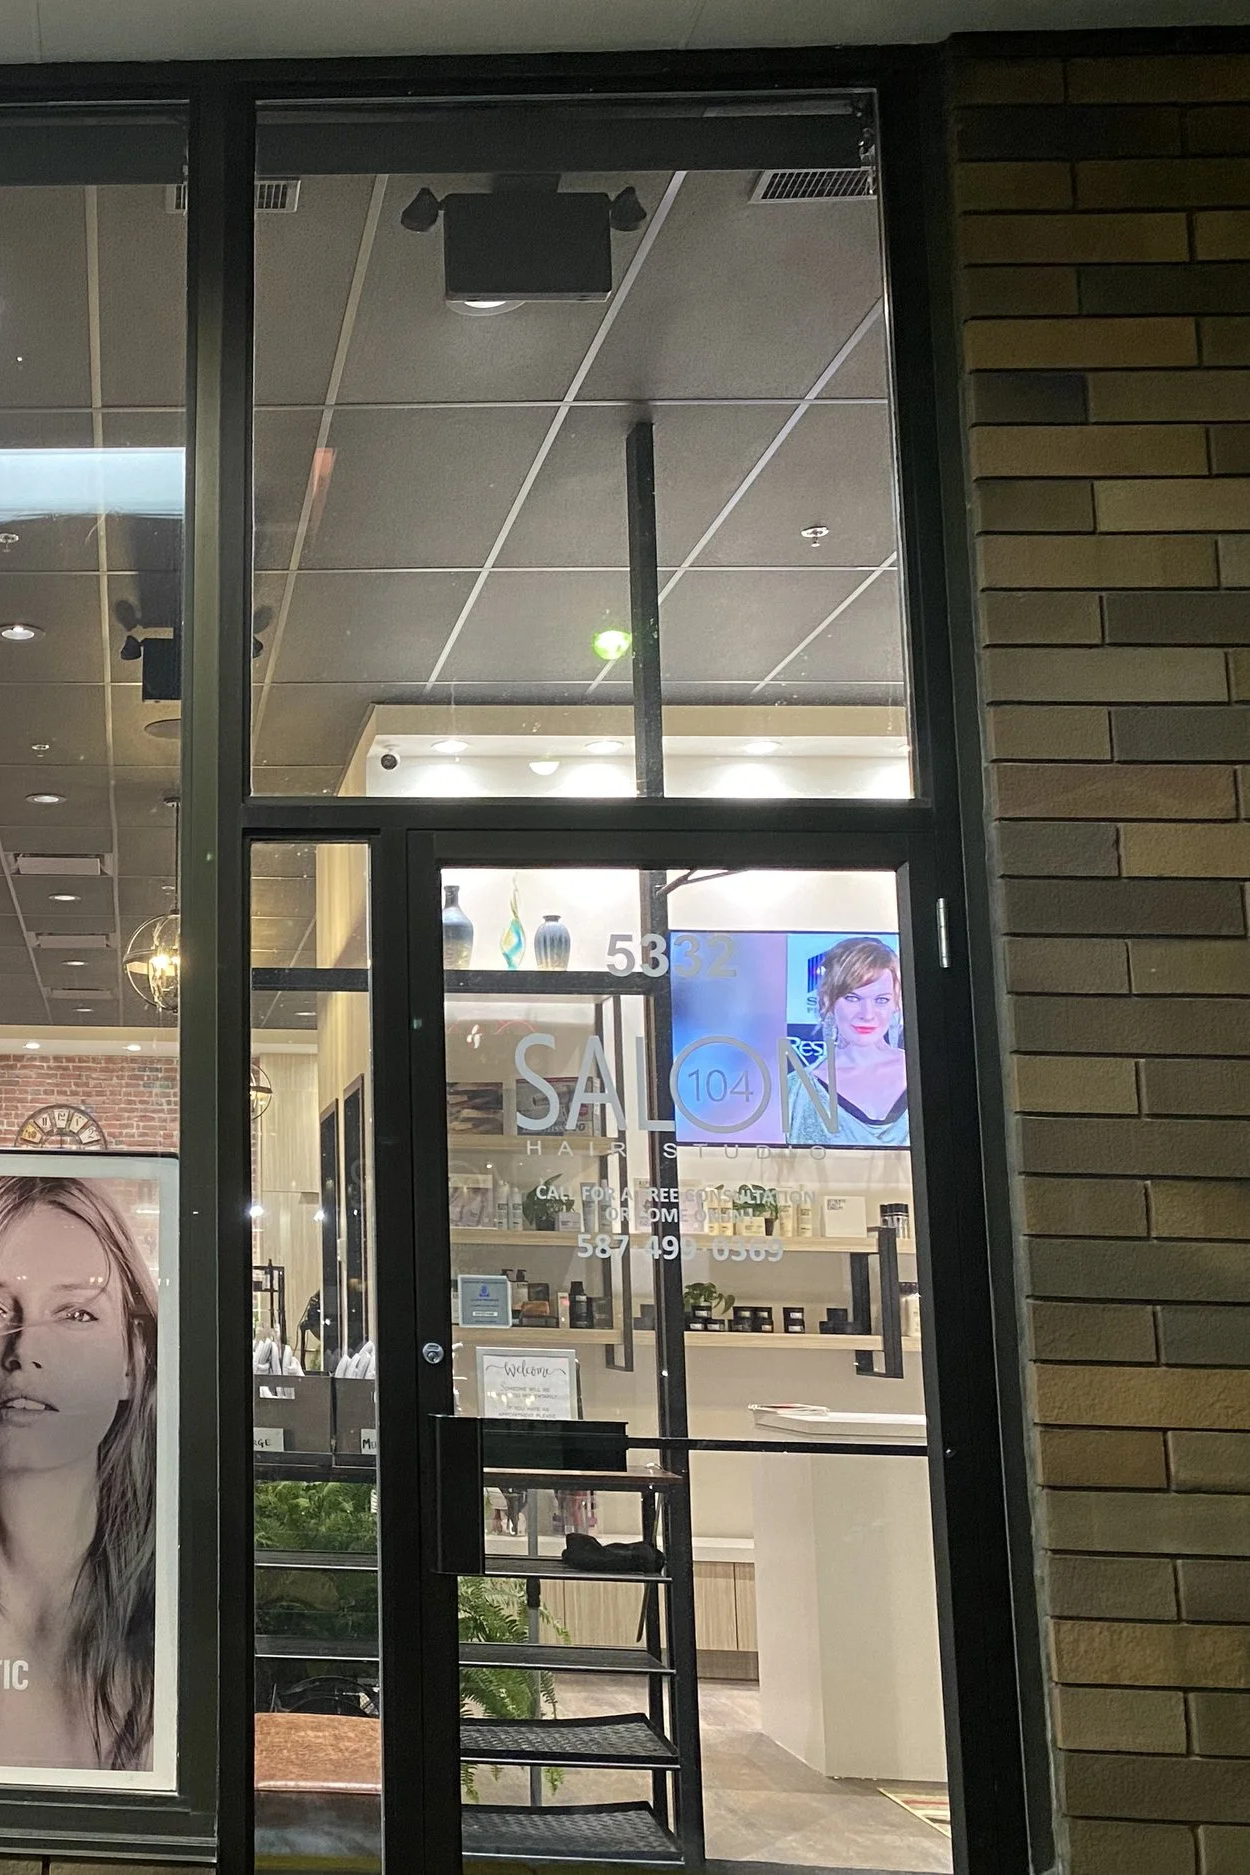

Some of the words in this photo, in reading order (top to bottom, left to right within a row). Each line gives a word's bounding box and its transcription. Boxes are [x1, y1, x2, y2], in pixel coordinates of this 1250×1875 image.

[606, 933, 737, 978] 5332
[514, 1033, 840, 1134] SALON
[687, 1069, 754, 1103] 104
[526, 1140, 627, 1158] HAIR
[662, 1143, 827, 1161] STUDIO
[536, 1185, 575, 1201] CALL
[582, 1187, 615, 1202] FOR
[621, 1187, 633, 1202] A
[686, 1188, 816, 1206] CONSULTATION
[606, 1208, 631, 1222] OR
[497, 1359, 558, 1378] Welcome
